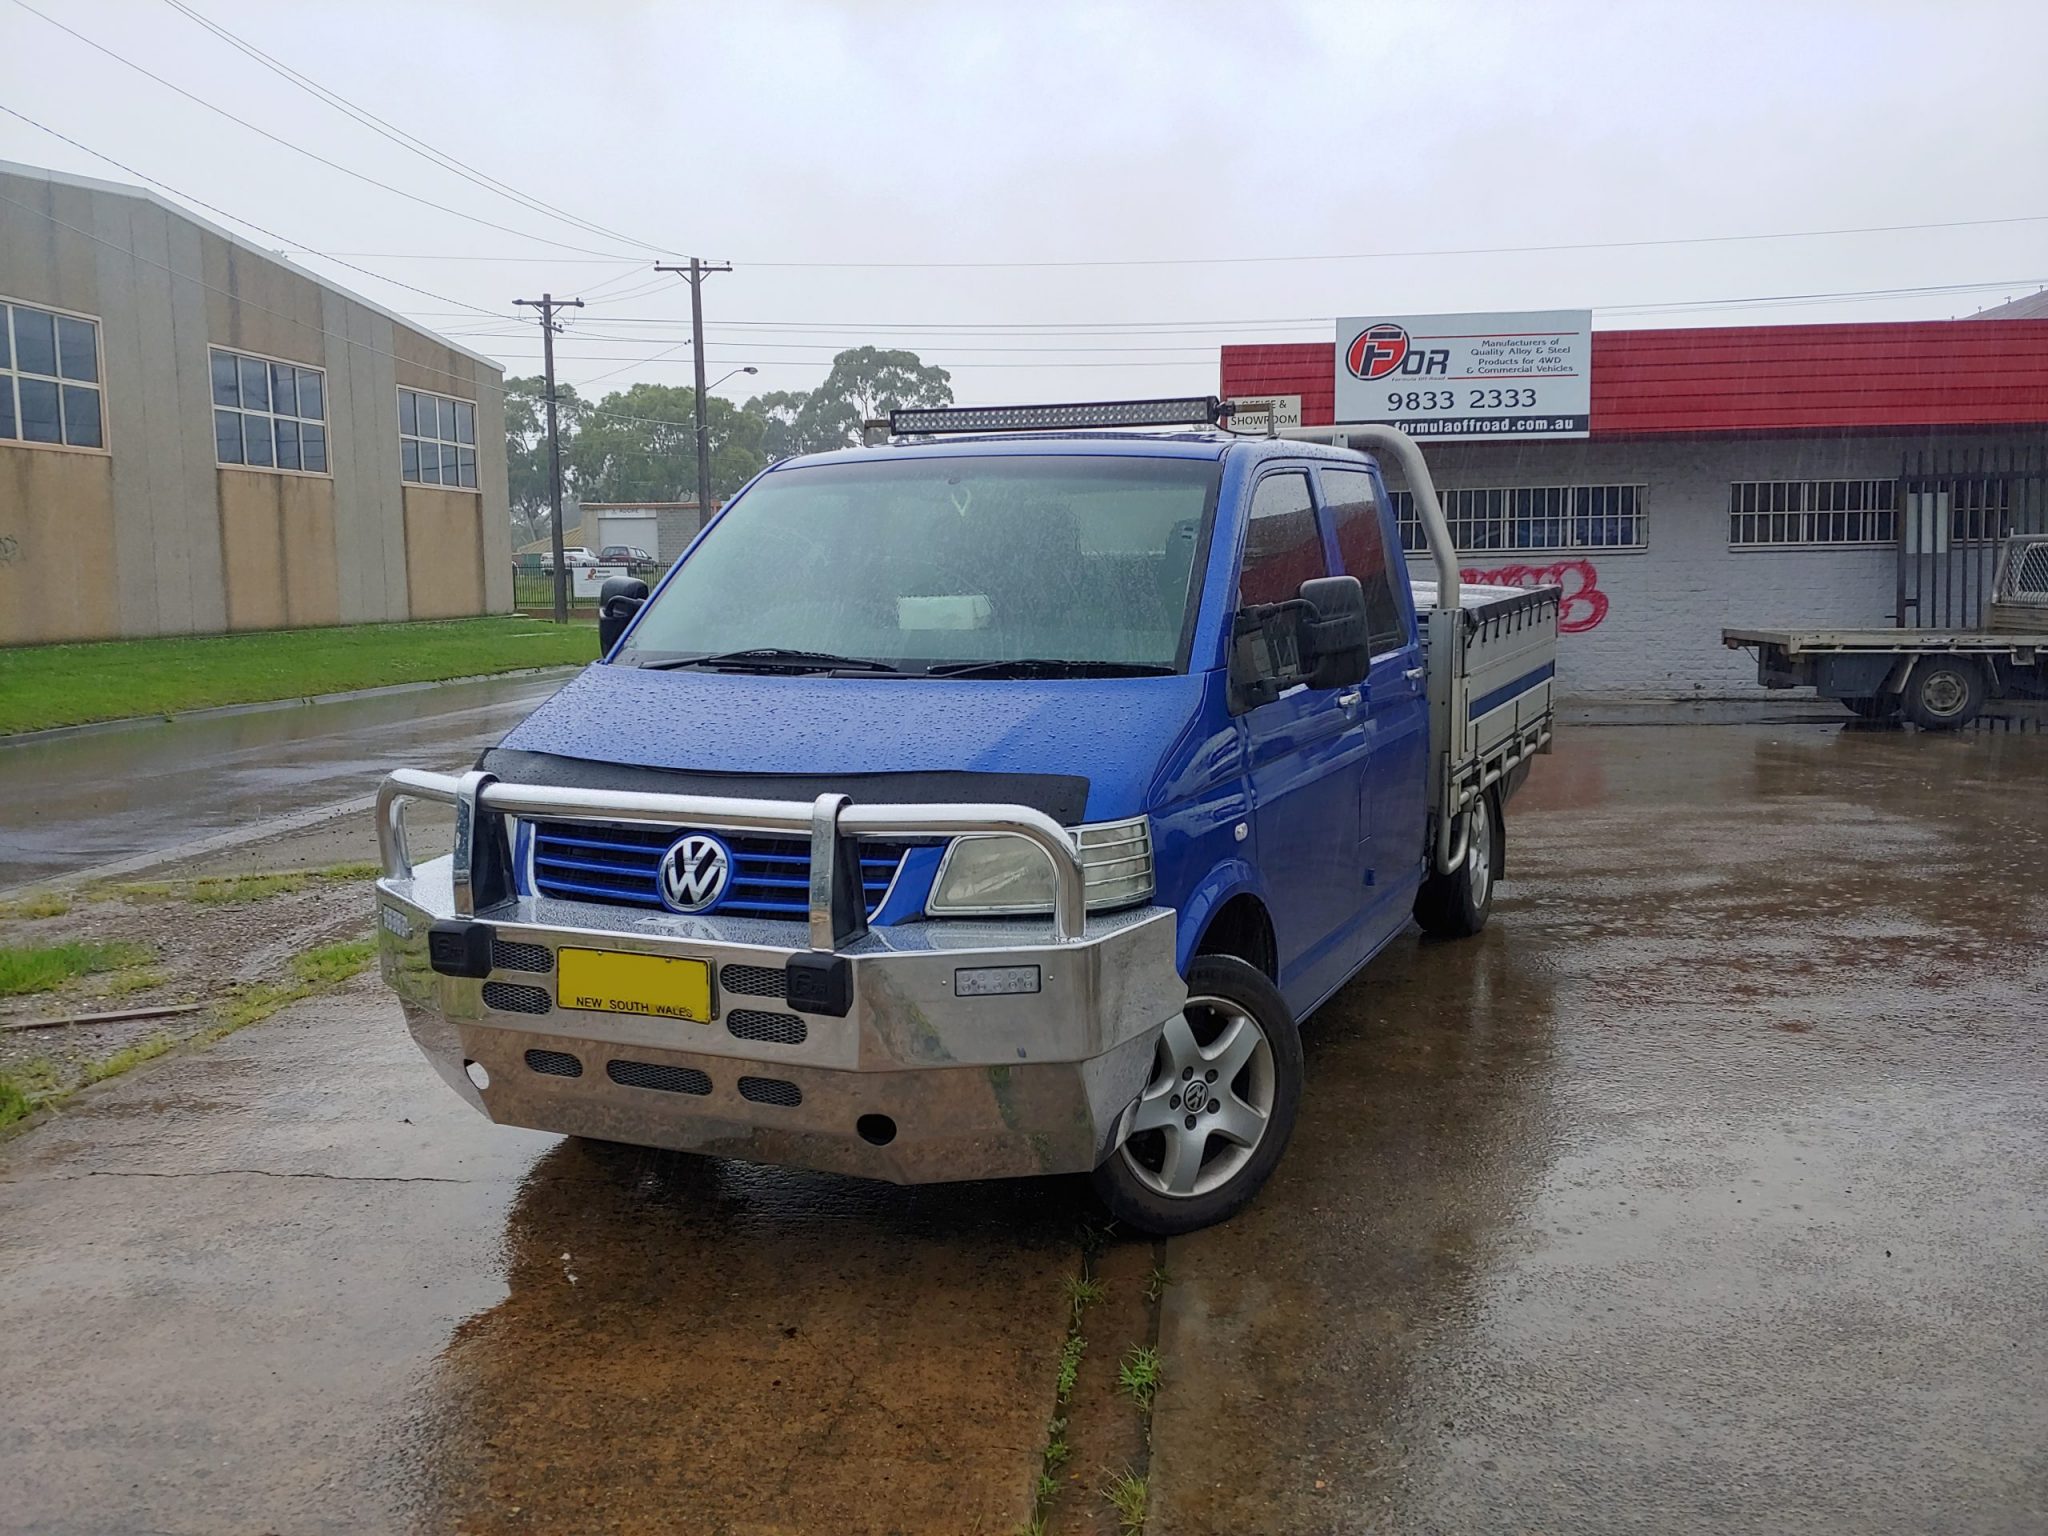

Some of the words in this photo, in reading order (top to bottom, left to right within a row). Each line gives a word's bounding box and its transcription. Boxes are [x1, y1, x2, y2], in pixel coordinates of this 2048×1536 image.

[1481, 339, 1546, 348] Manufacturers
[1550, 338, 1560, 346] of
[1470, 348, 1504, 357] Quality
[1508, 347, 1533, 356] Alloy
[1547, 346, 1571, 354] Steel
[1478, 358, 1519, 366] Products
[1522, 357, 1535, 365] for
[1538, 356, 1562, 364] 4WD
[1466, 366, 1474, 374] &
[1478, 365, 1533, 374] Commercial
[1536, 364, 1573, 373] Vehicles
[1279, 399, 1287, 409] &
[1387, 391, 1455, 412] 9833
[1469, 388, 1537, 409] 2333
[576, 996, 602, 1008] NEW
[609, 999, 649, 1012] SOUTH
[655, 1005, 693, 1018] WALES
